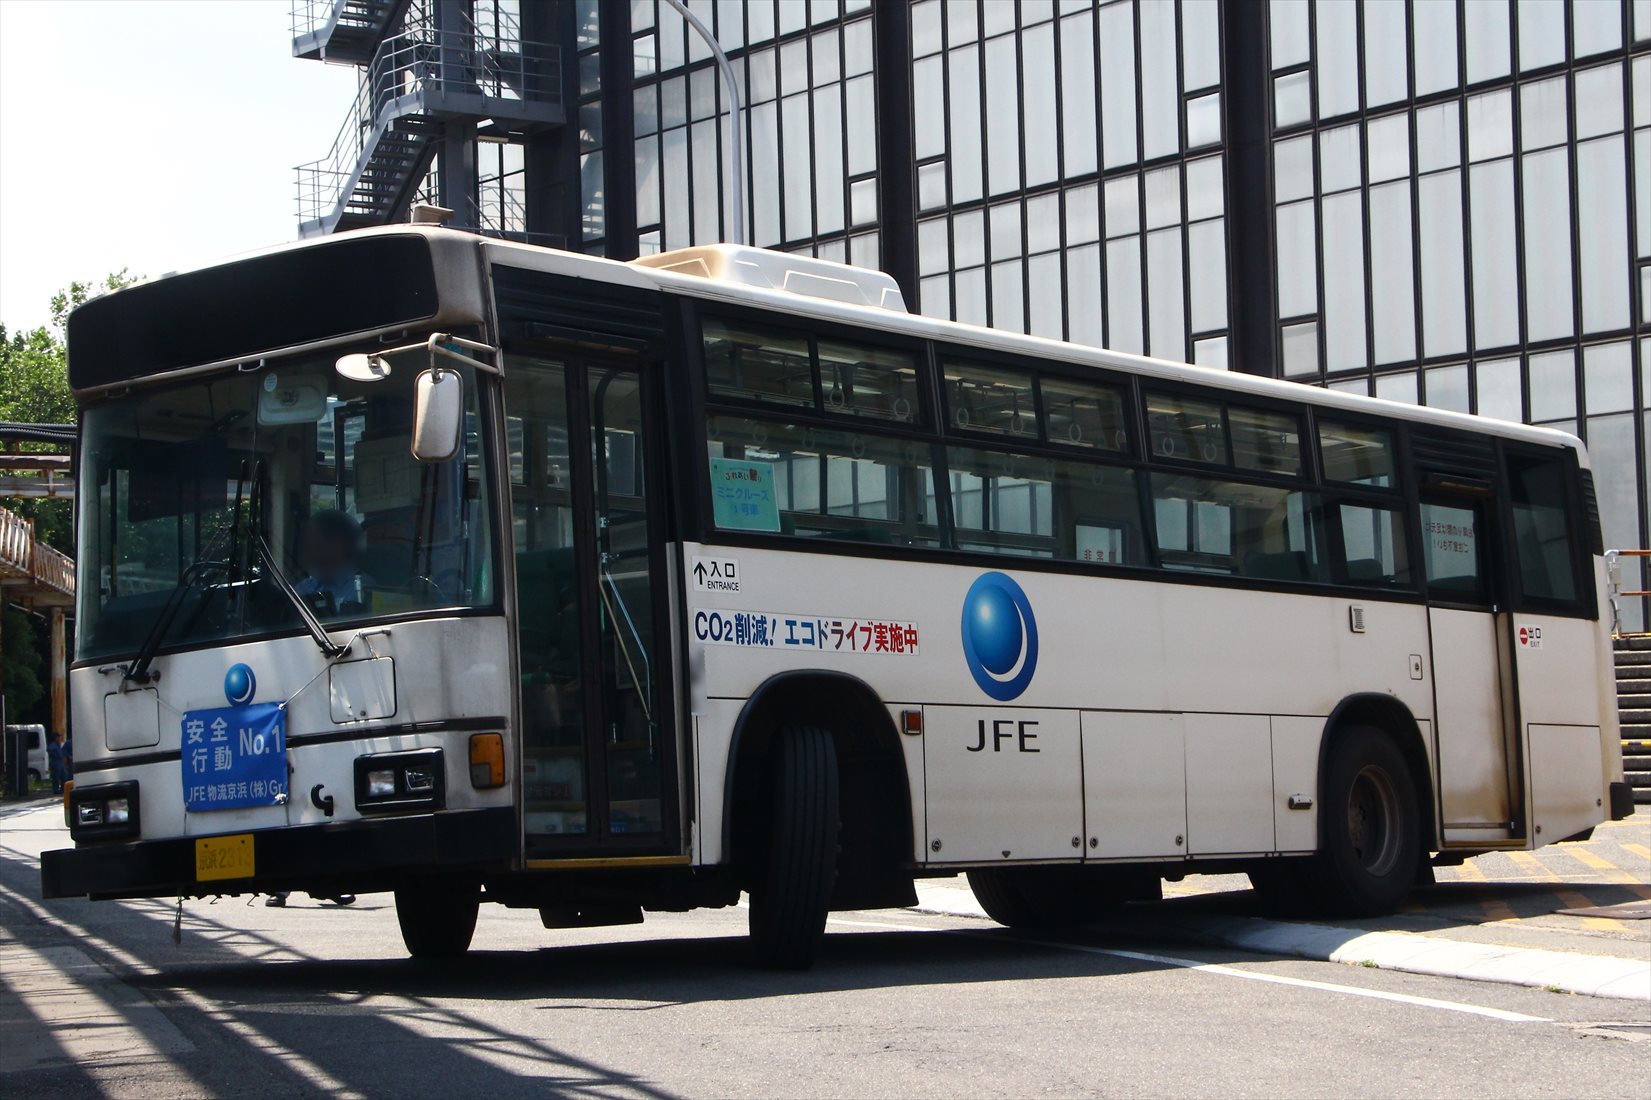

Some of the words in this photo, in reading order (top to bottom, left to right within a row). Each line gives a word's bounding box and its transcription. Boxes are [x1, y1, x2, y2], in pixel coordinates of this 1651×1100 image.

[711, 561, 735, 578] 入口
[707, 580, 739, 591] ENTRANCE
[1528, 627, 1541, 639] 出口
[186, 717, 228, 744] 安全
[240, 724, 281, 757] No.1
[966, 720, 1040, 752] JFE
[192, 745, 232, 773] 行動
